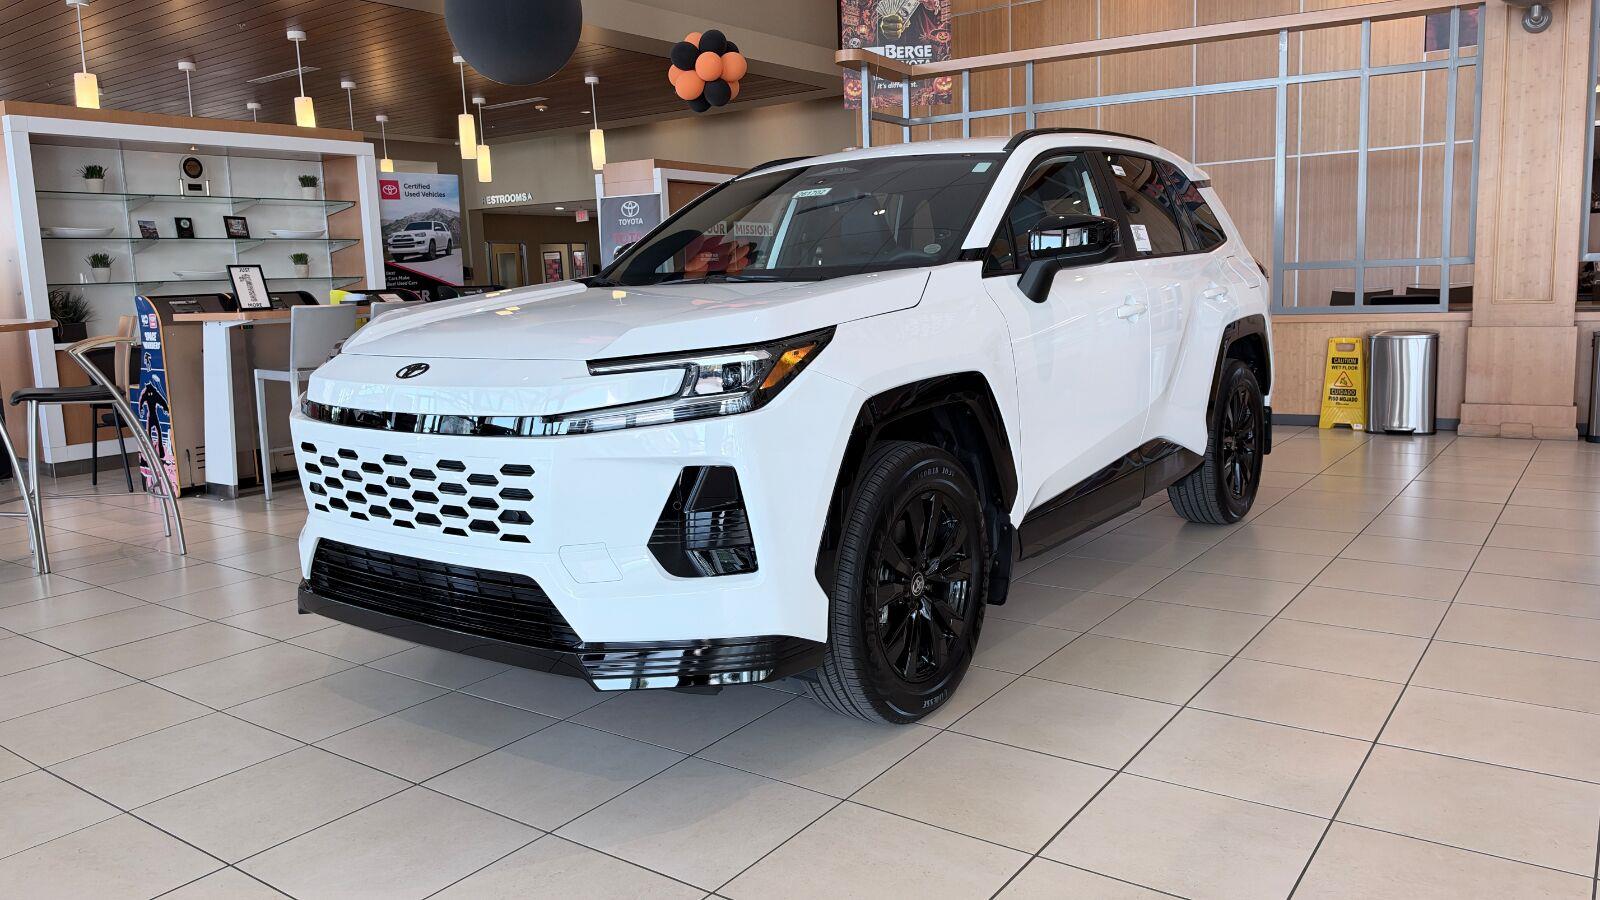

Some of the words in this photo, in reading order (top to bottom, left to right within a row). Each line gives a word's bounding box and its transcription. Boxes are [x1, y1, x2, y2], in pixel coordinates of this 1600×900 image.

[885, 44, 932, 59] BERGE
[618, 217, 644, 226] TOYOTA
[735, 224, 773, 235] MISSION:
[1331, 388, 1356, 396] CUIDADO
